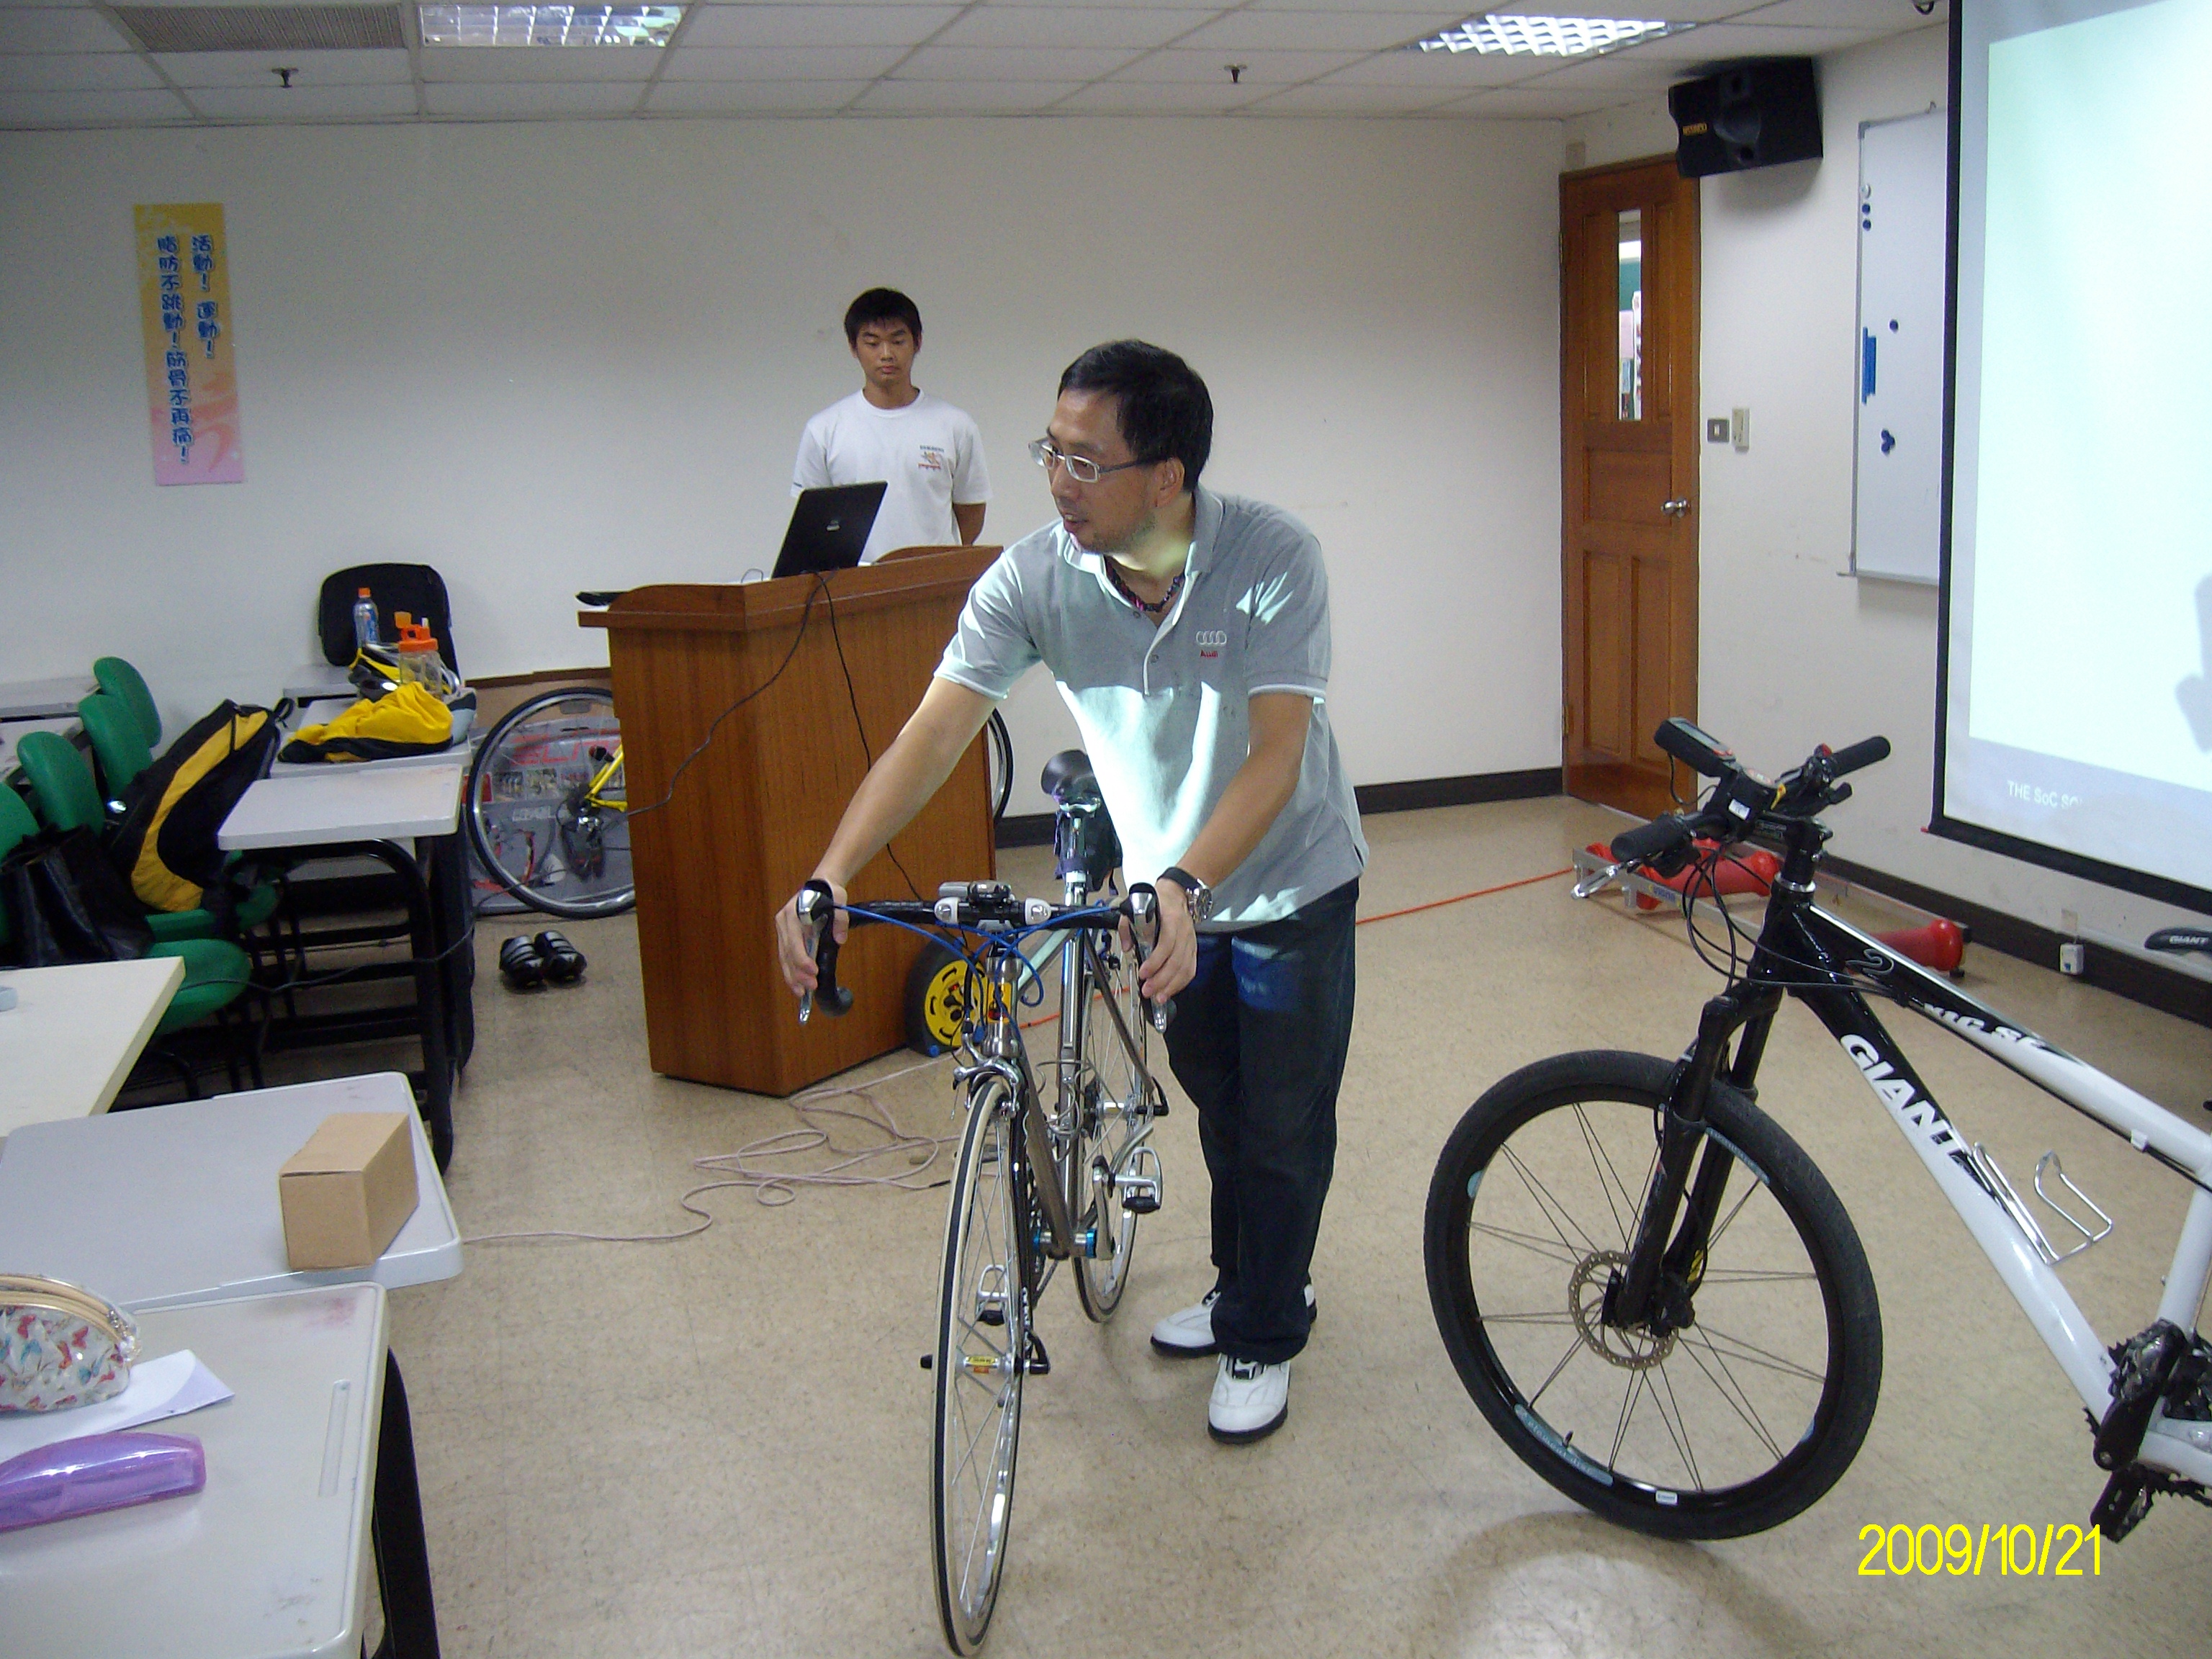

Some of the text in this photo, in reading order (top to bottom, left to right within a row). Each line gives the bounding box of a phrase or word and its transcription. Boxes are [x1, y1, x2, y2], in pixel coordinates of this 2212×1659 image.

[1200, 649, 1218, 658] Audi
[511, 739, 620, 766] ELIT
[2007, 780, 2031, 801] THE
[2034, 787, 2058, 808] SoC
[2169, 935, 2209, 945] GIANT
[1840, 1033, 1972, 1158] GIANT
